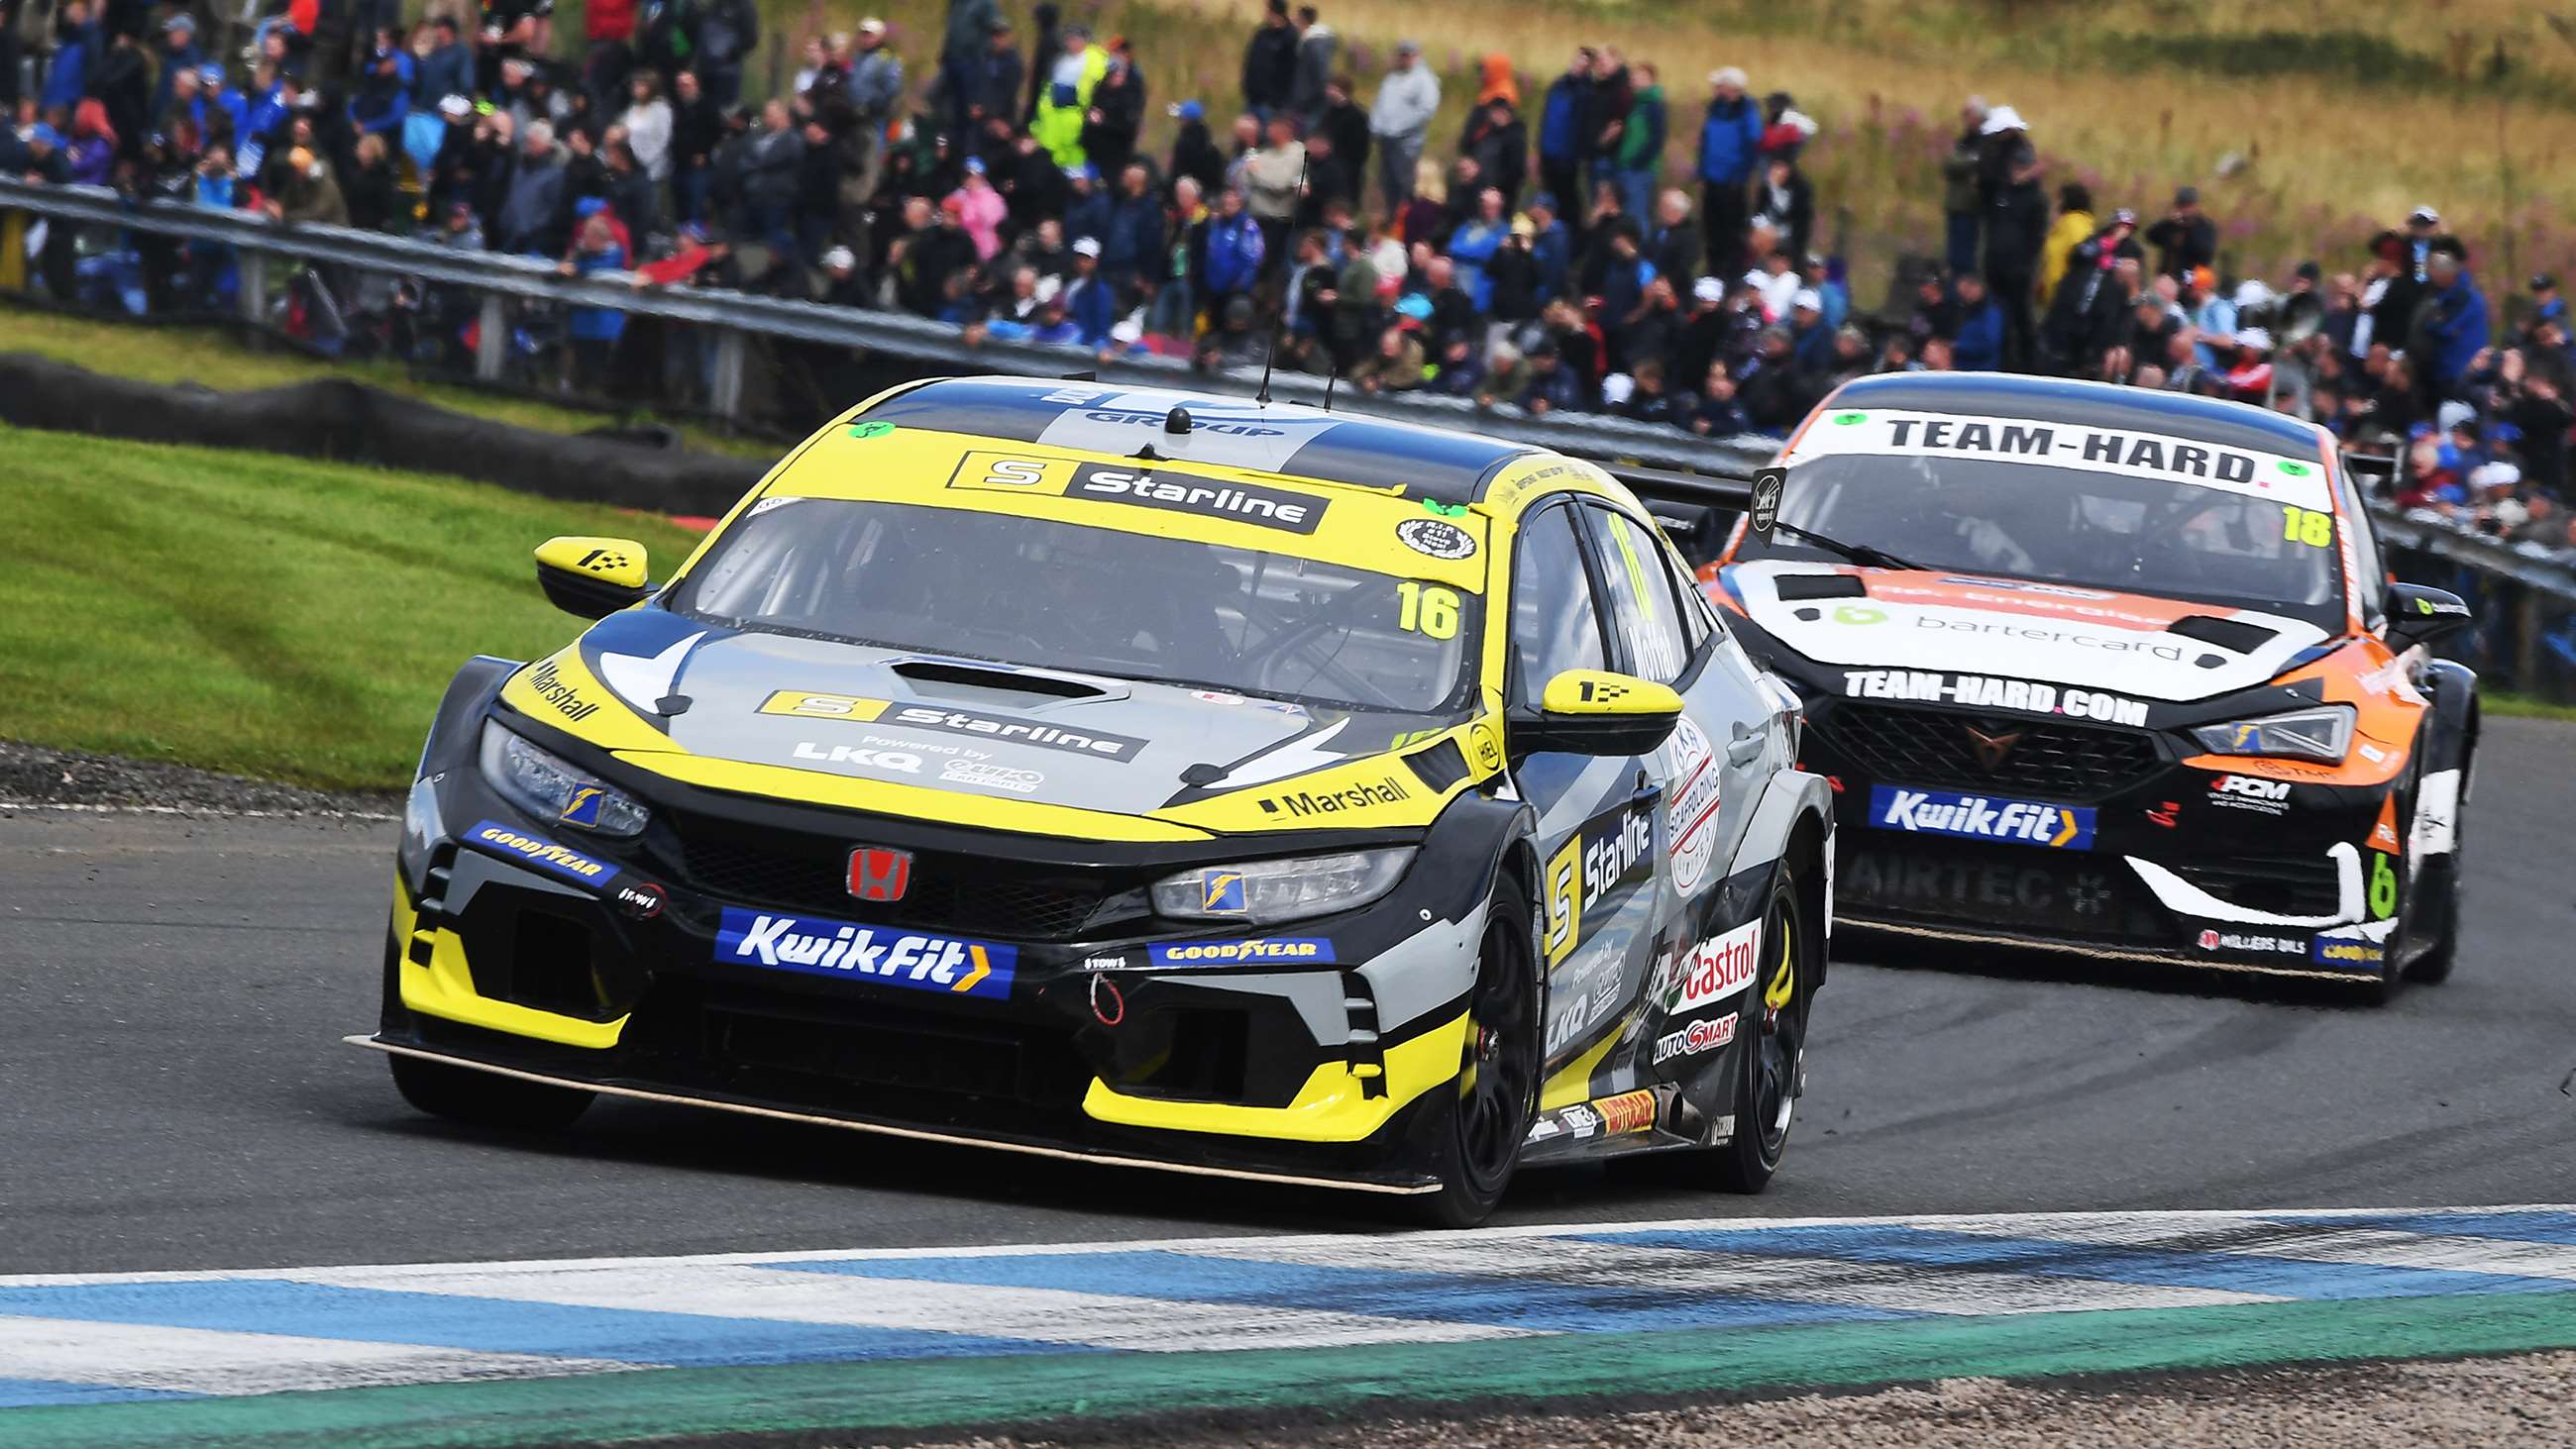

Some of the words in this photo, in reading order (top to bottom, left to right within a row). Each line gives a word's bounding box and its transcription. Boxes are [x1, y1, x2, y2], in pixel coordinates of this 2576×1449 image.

[1885, 418, 2271, 488] TEAM-HARD.
[1083, 471, 1307, 524] Starline
[2283, 505, 2331, 548] 18
[1396, 581, 1460, 641] 16
[1916, 615, 2183, 662] bartercard
[530, 667, 599, 722] Marshall
[1843, 670, 2149, 727] TEAM-HARD.COM
[896, 708, 1125, 754] Starline
[793, 743, 923, 774] LKQ
[962, 749, 994, 762] by
[1281, 776, 1411, 817] Marshall
[481, 829, 602, 877] GOODYEAR
[1585, 809, 1649, 912] Starline
[1166, 940, 1317, 961] GOODYEAR
[1685, 929, 1756, 999] Castrol
